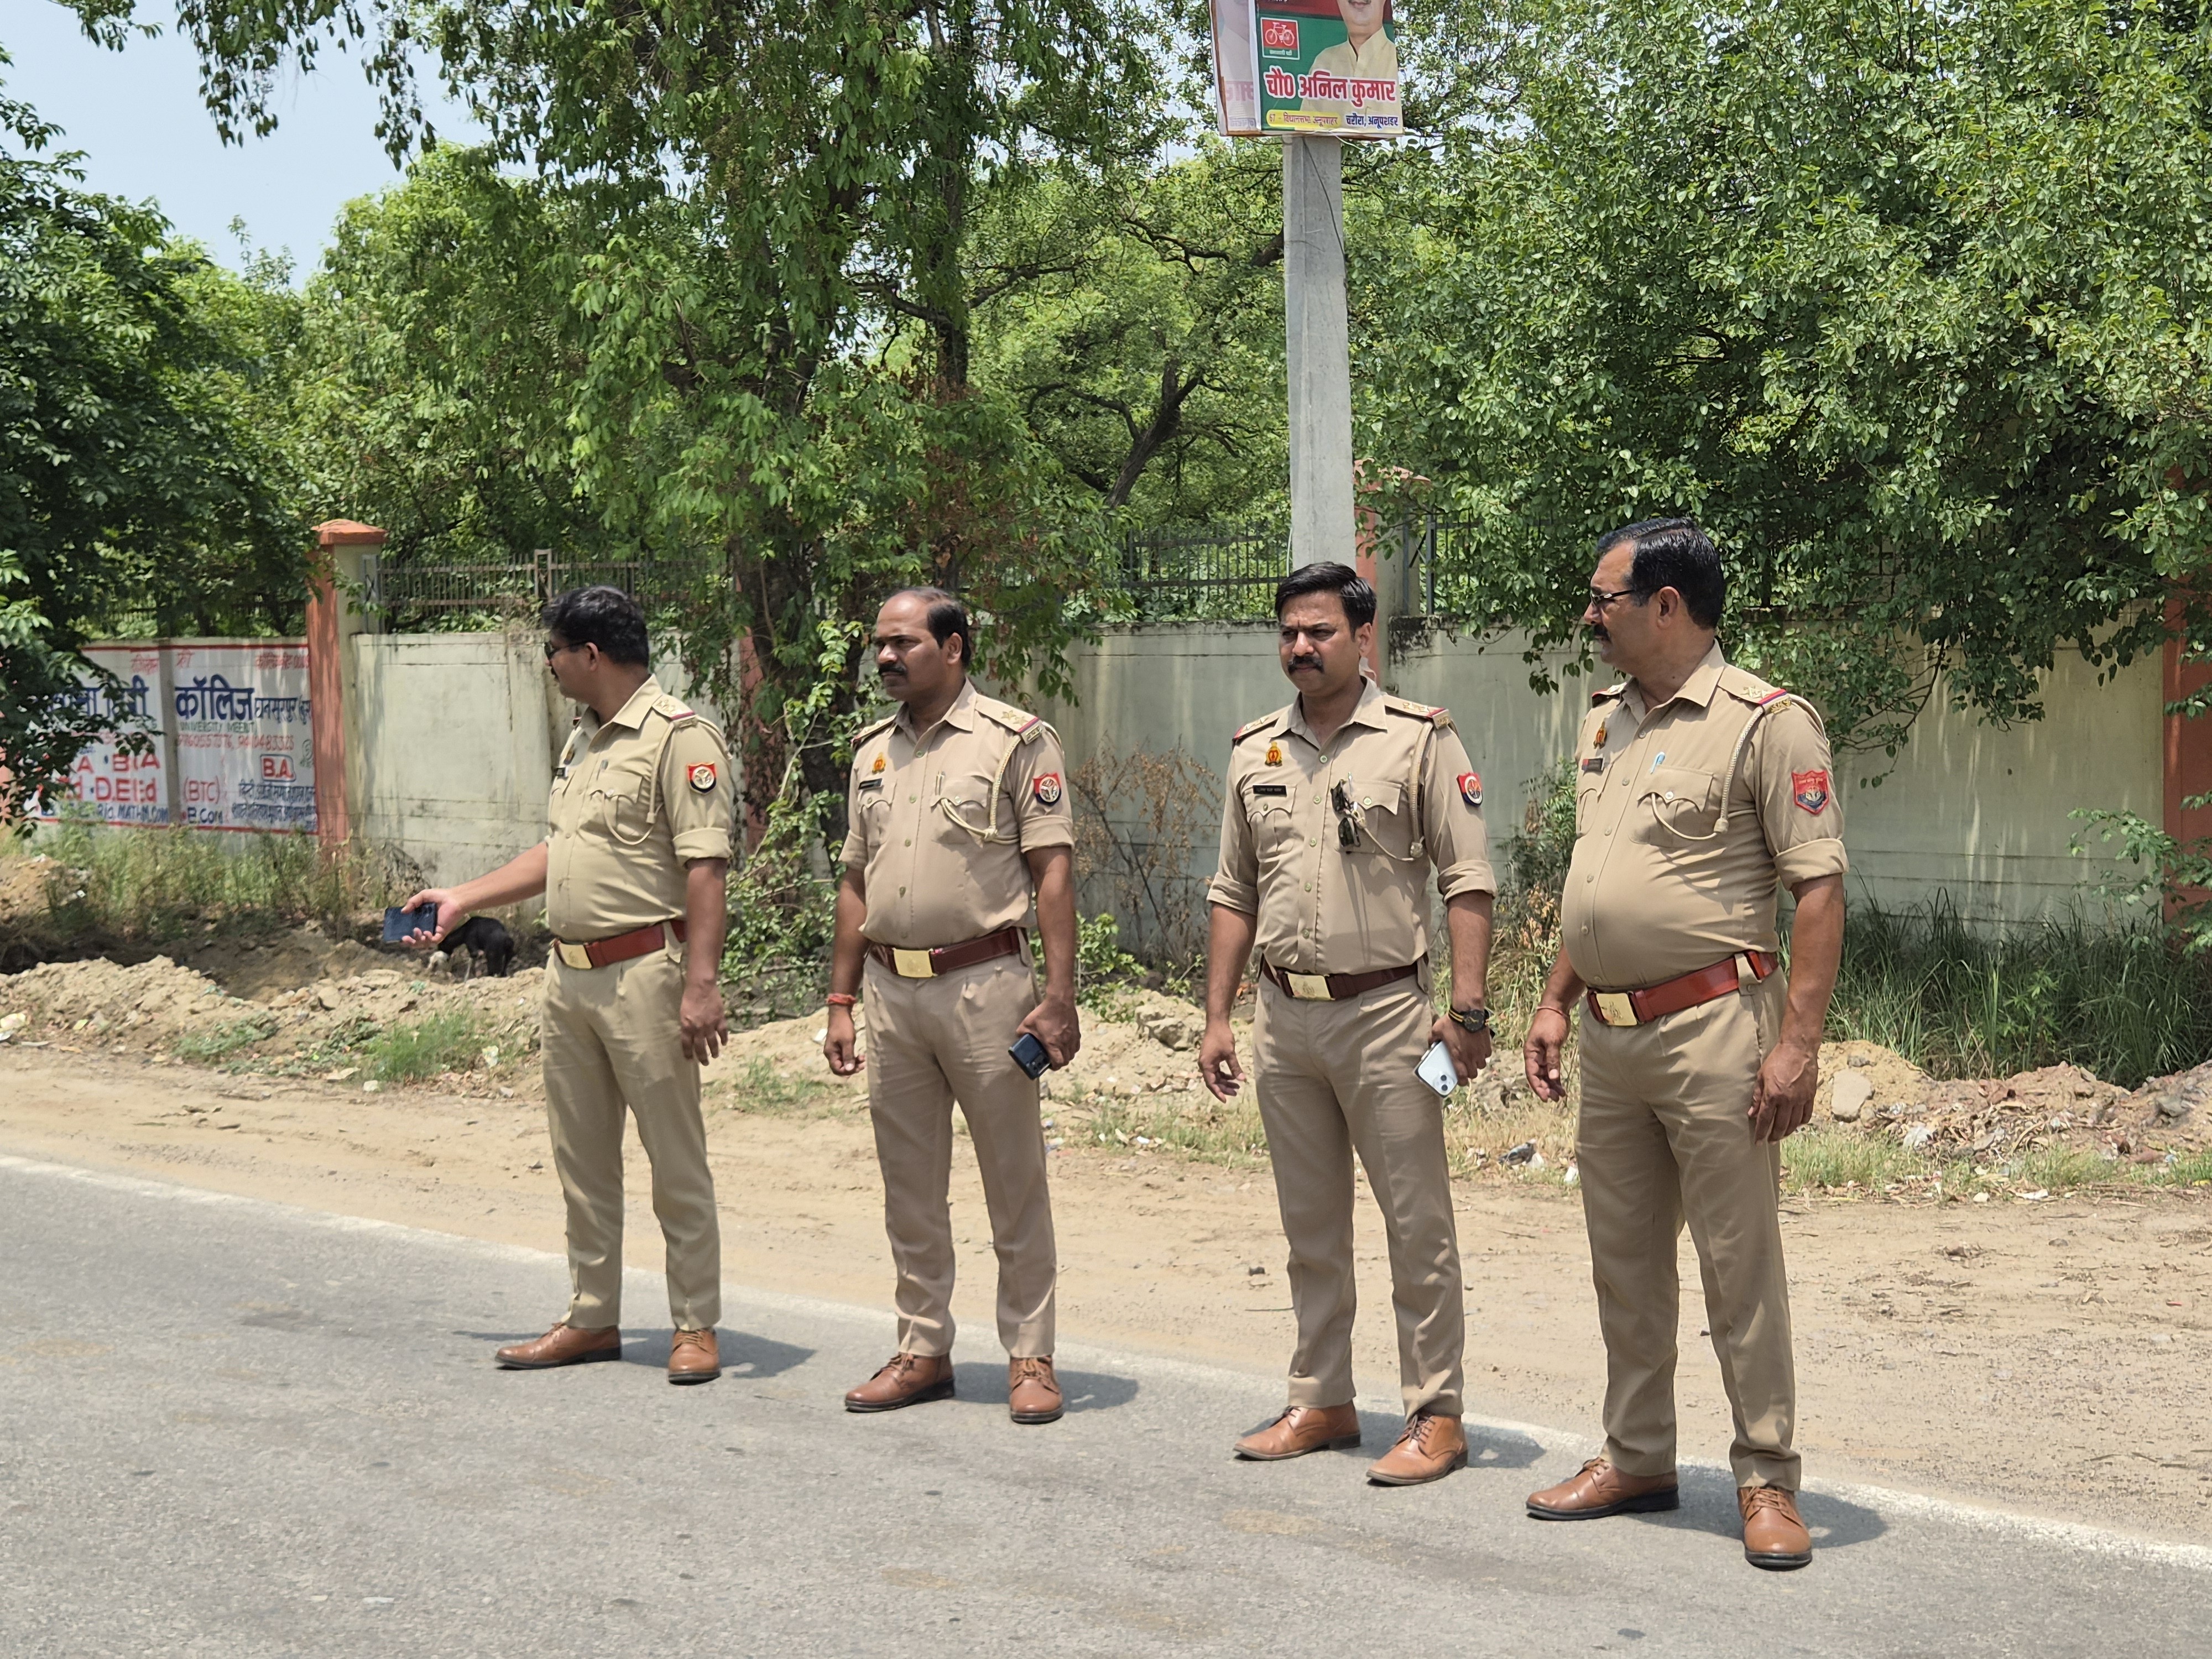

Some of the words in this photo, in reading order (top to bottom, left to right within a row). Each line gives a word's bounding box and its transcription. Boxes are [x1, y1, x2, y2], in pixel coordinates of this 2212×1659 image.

[1300, 71, 1348, 99] अनिल
[1350, 79, 1396, 107] कुमार
[184, 775, 220, 804] (BTC)
